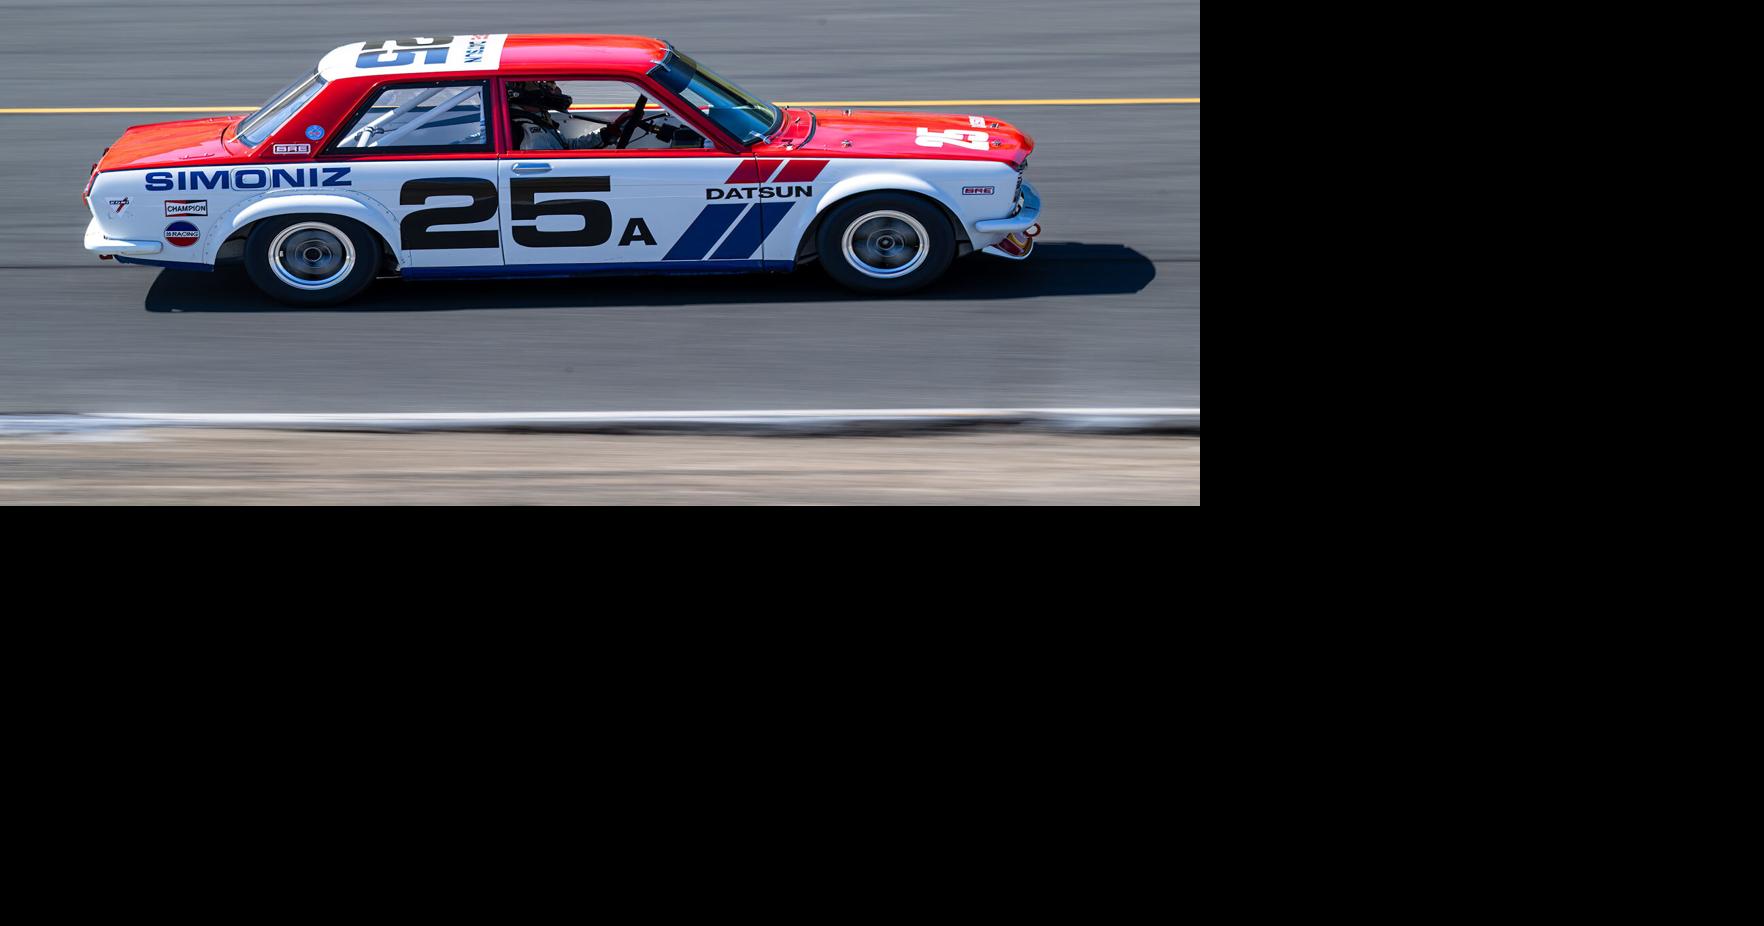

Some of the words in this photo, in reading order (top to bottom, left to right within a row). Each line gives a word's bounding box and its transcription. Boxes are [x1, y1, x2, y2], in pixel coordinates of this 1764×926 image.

[915, 127, 990, 151] 25
[145, 167, 352, 191] SIMONIZ
[706, 185, 813, 200] DATSUN
[167, 204, 206, 212] CHAMPION
[400, 176, 613, 250] 25
[618, 217, 658, 246] A
